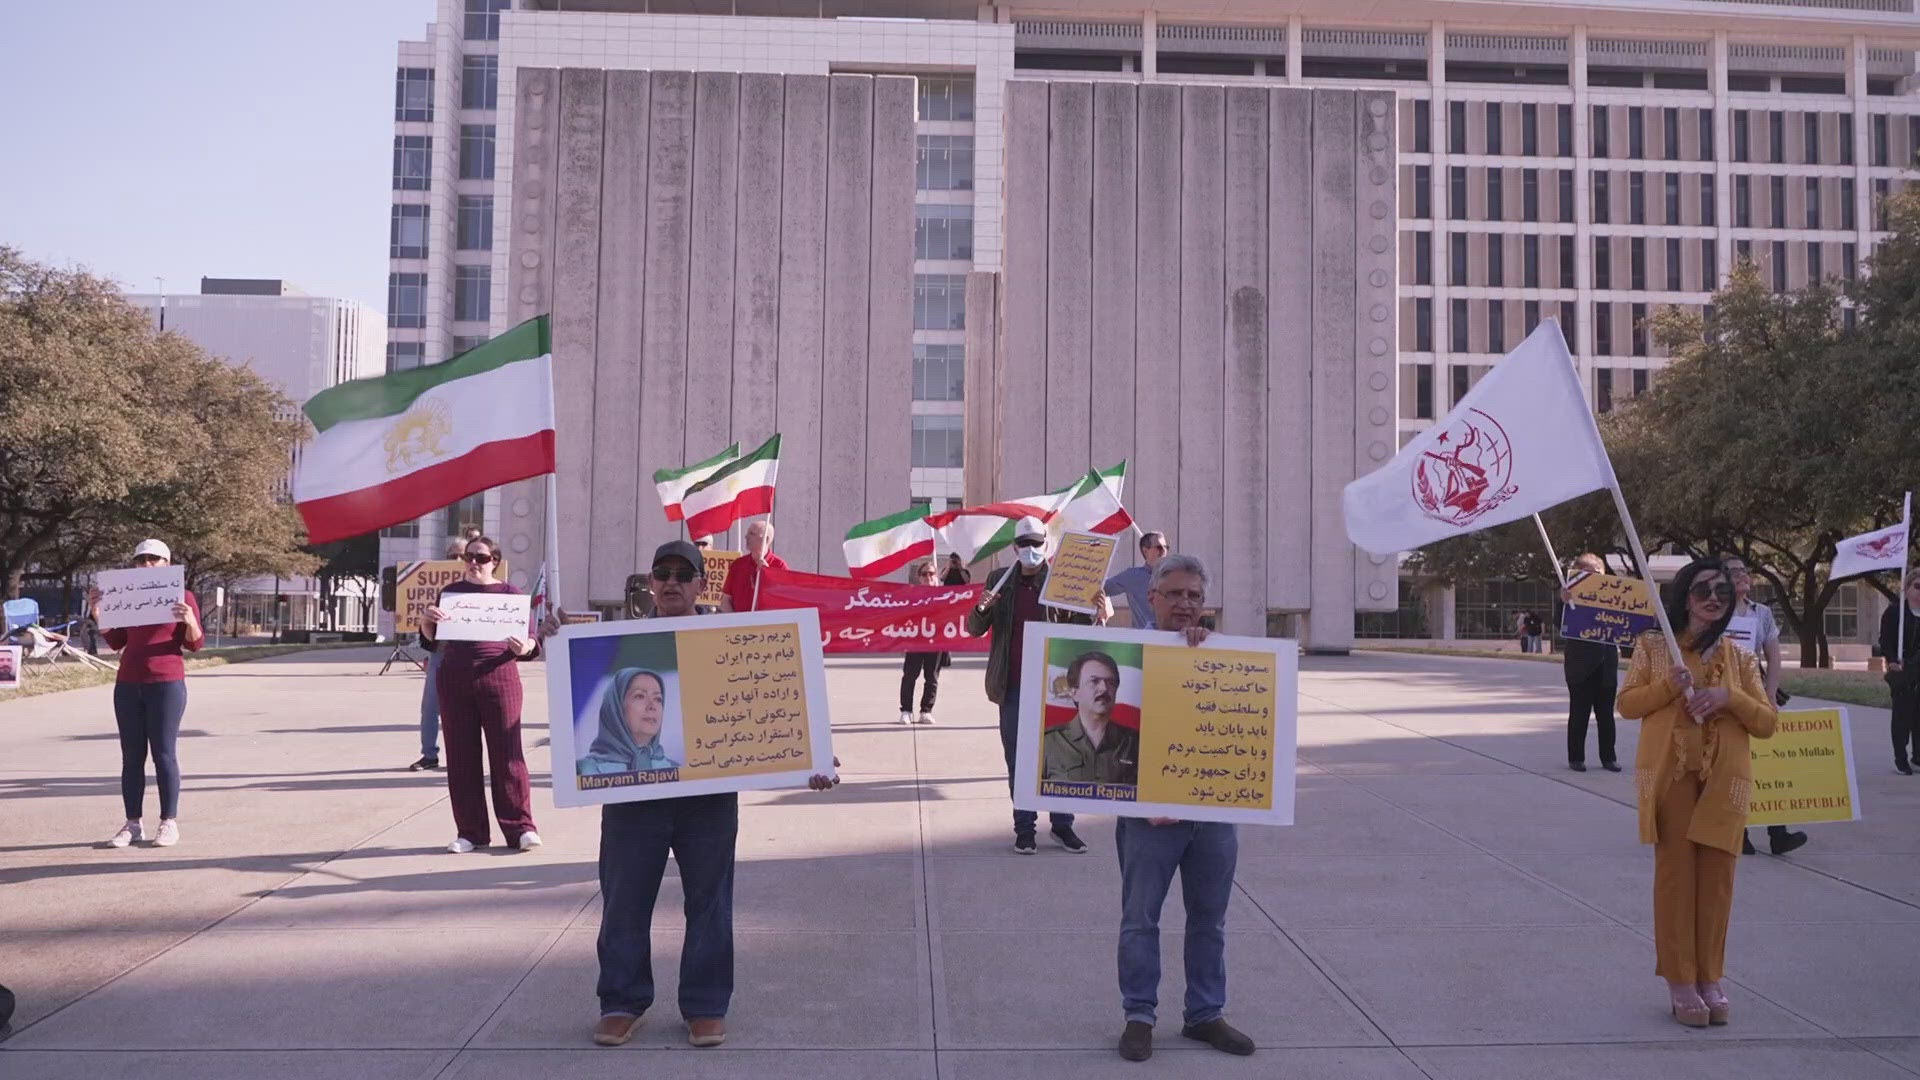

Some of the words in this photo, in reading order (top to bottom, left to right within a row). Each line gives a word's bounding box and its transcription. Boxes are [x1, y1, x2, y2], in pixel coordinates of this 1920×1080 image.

[417, 570, 466, 586] SUPP
[1599, 581, 1608, 590] بر
[1610, 581, 1632, 593] مرگ
[406, 587, 439, 600] UPRI
[844, 586, 910, 610] ستمگر
[497, 602, 520, 613] مرگ
[1628, 598, 1648, 610] اصل
[881, 617, 937, 643] باشه
[943, 616, 988, 638] اه
[1580, 627, 1613, 641] آزادی
[725, 633, 765, 646] رجوی:
[767, 632, 791, 643] مریم
[839, 626, 875, 646] چه
[716, 651, 743, 666] ایران
[746, 652, 772, 664] مردم
[775, 647, 795, 662] قیام
[727, 668, 770, 684] خواست
[772, 670, 797, 682] مبین
[1236, 662, 1269, 676] مسعود
[1182, 677, 1218, 694] آخوند
[1219, 681, 1268, 696] حاکمیت
[713, 692, 739, 706] برای
[741, 688, 759, 703] آنها
[763, 687, 790, 699] اراده
[793, 688, 799, 700] و
[1195, 700, 1216, 714] فقیه
[1219, 702, 1260, 714] سلطنت
[1262, 707, 1268, 718] و
[705, 708, 752, 727] آخوندها
[755, 708, 801, 724] سرنگونی
[1218, 723, 1244, 739] پایان
[1247, 725, 1268, 739] باید
[1775, 719, 1833, 733] FREEDOM
[705, 732, 754, 749] دمکراسی
[758, 728, 793, 744] استقرار
[797, 729, 803, 740] و
[695, 738, 702, 749] و
[1168, 743, 1196, 757] مردم
[1199, 744, 1247, 757] حاکمیت
[756, 747, 804, 763] حاکمیت
[1250, 746, 1258, 760] با
[1261, 749, 1267, 760] و
[1772, 749, 1785, 758] No
[1787, 749, 1797, 758] to
[1799, 747, 1836, 757] Mullahs
[688, 755, 715, 768] است
[718, 754, 755, 769] مردمی
[582, 774, 634, 788] Maryam
[638, 768, 678, 783] Rajavi
[1162, 764, 1190, 778] مردم
[1193, 767, 1231, 780] جمهور
[1260, 770, 1266, 782] و
[1043, 782, 1093, 797] Masoud
[1096, 784, 1135, 801] Rajavi
[1755, 780, 1772, 790] Yes
[1775, 780, 1785, 789] to
[1188, 786, 1215, 801] شود.
[1216, 788, 1264, 803] جایگزین
[1750, 799, 1787, 812] RATIC
[1790, 796, 1848, 810] REPUBLIC
